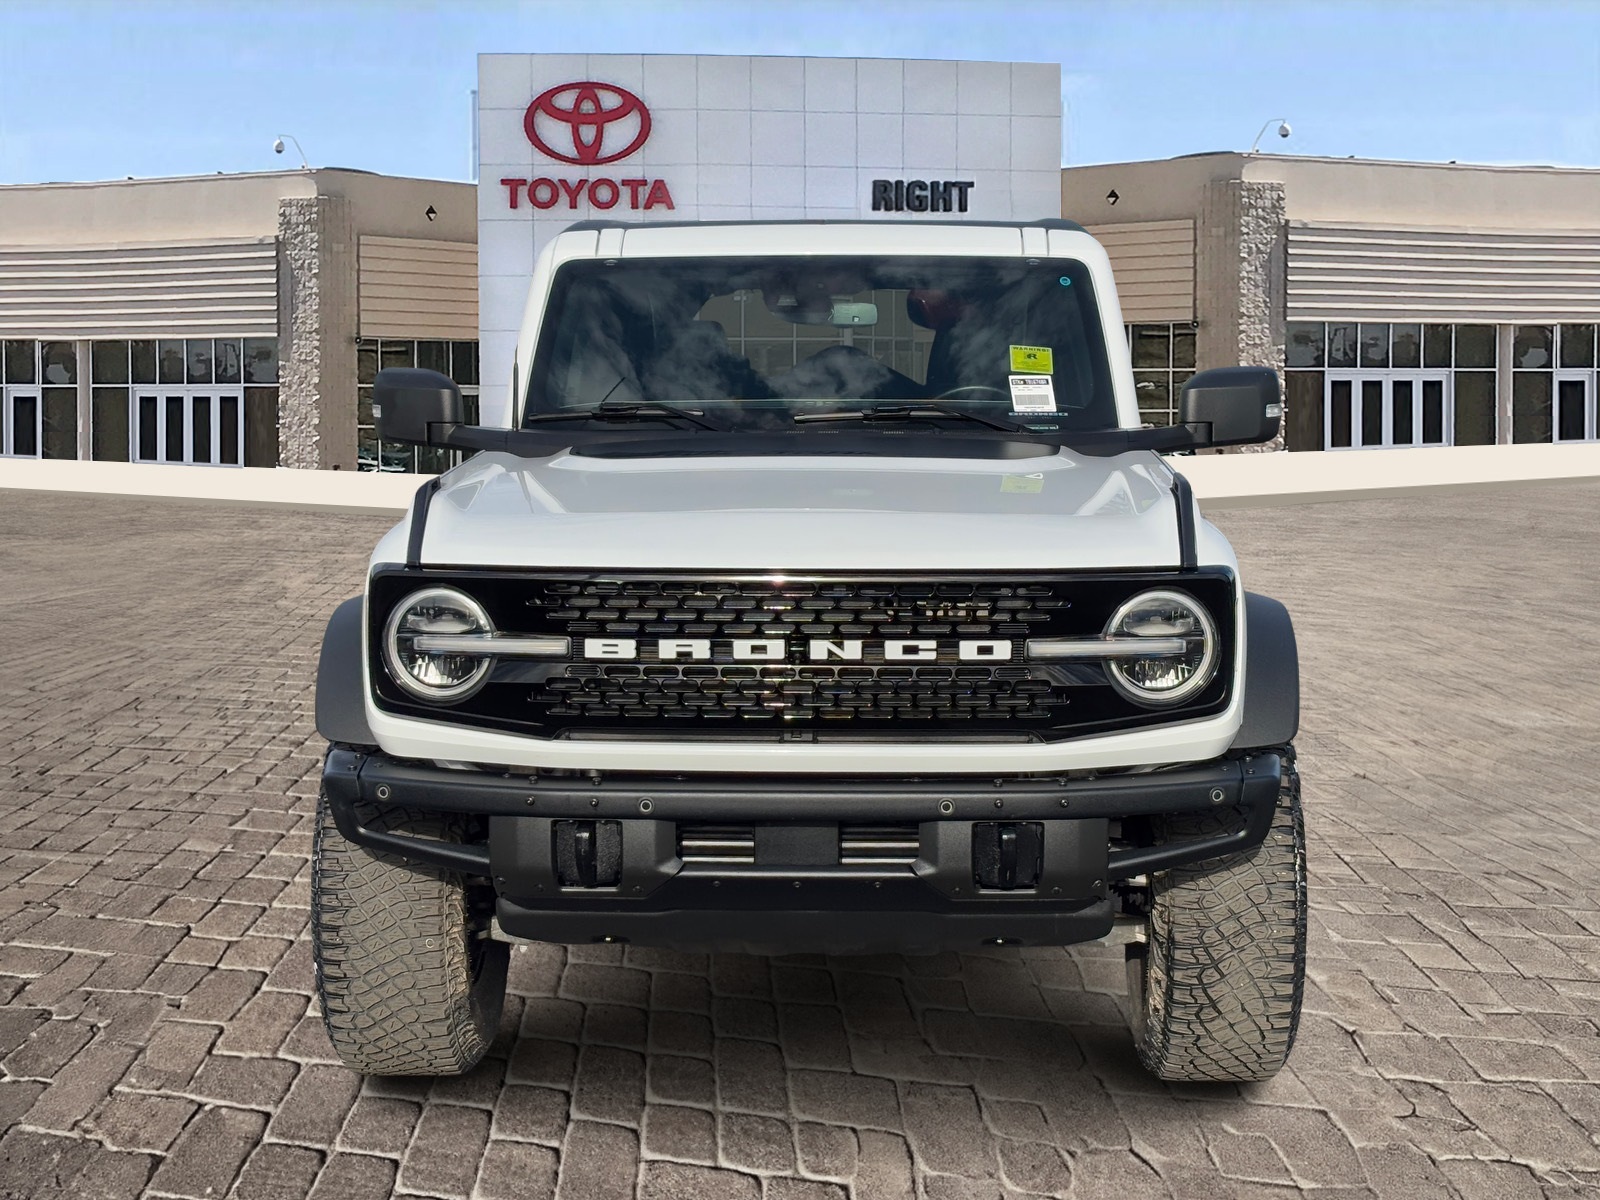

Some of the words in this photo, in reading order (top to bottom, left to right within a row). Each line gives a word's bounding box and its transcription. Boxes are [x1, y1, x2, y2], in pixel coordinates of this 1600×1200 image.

[500, 178, 675, 210] TOYOTA
[872, 179, 975, 212] RIGHT
[584, 638, 1013, 660] BRONCO
